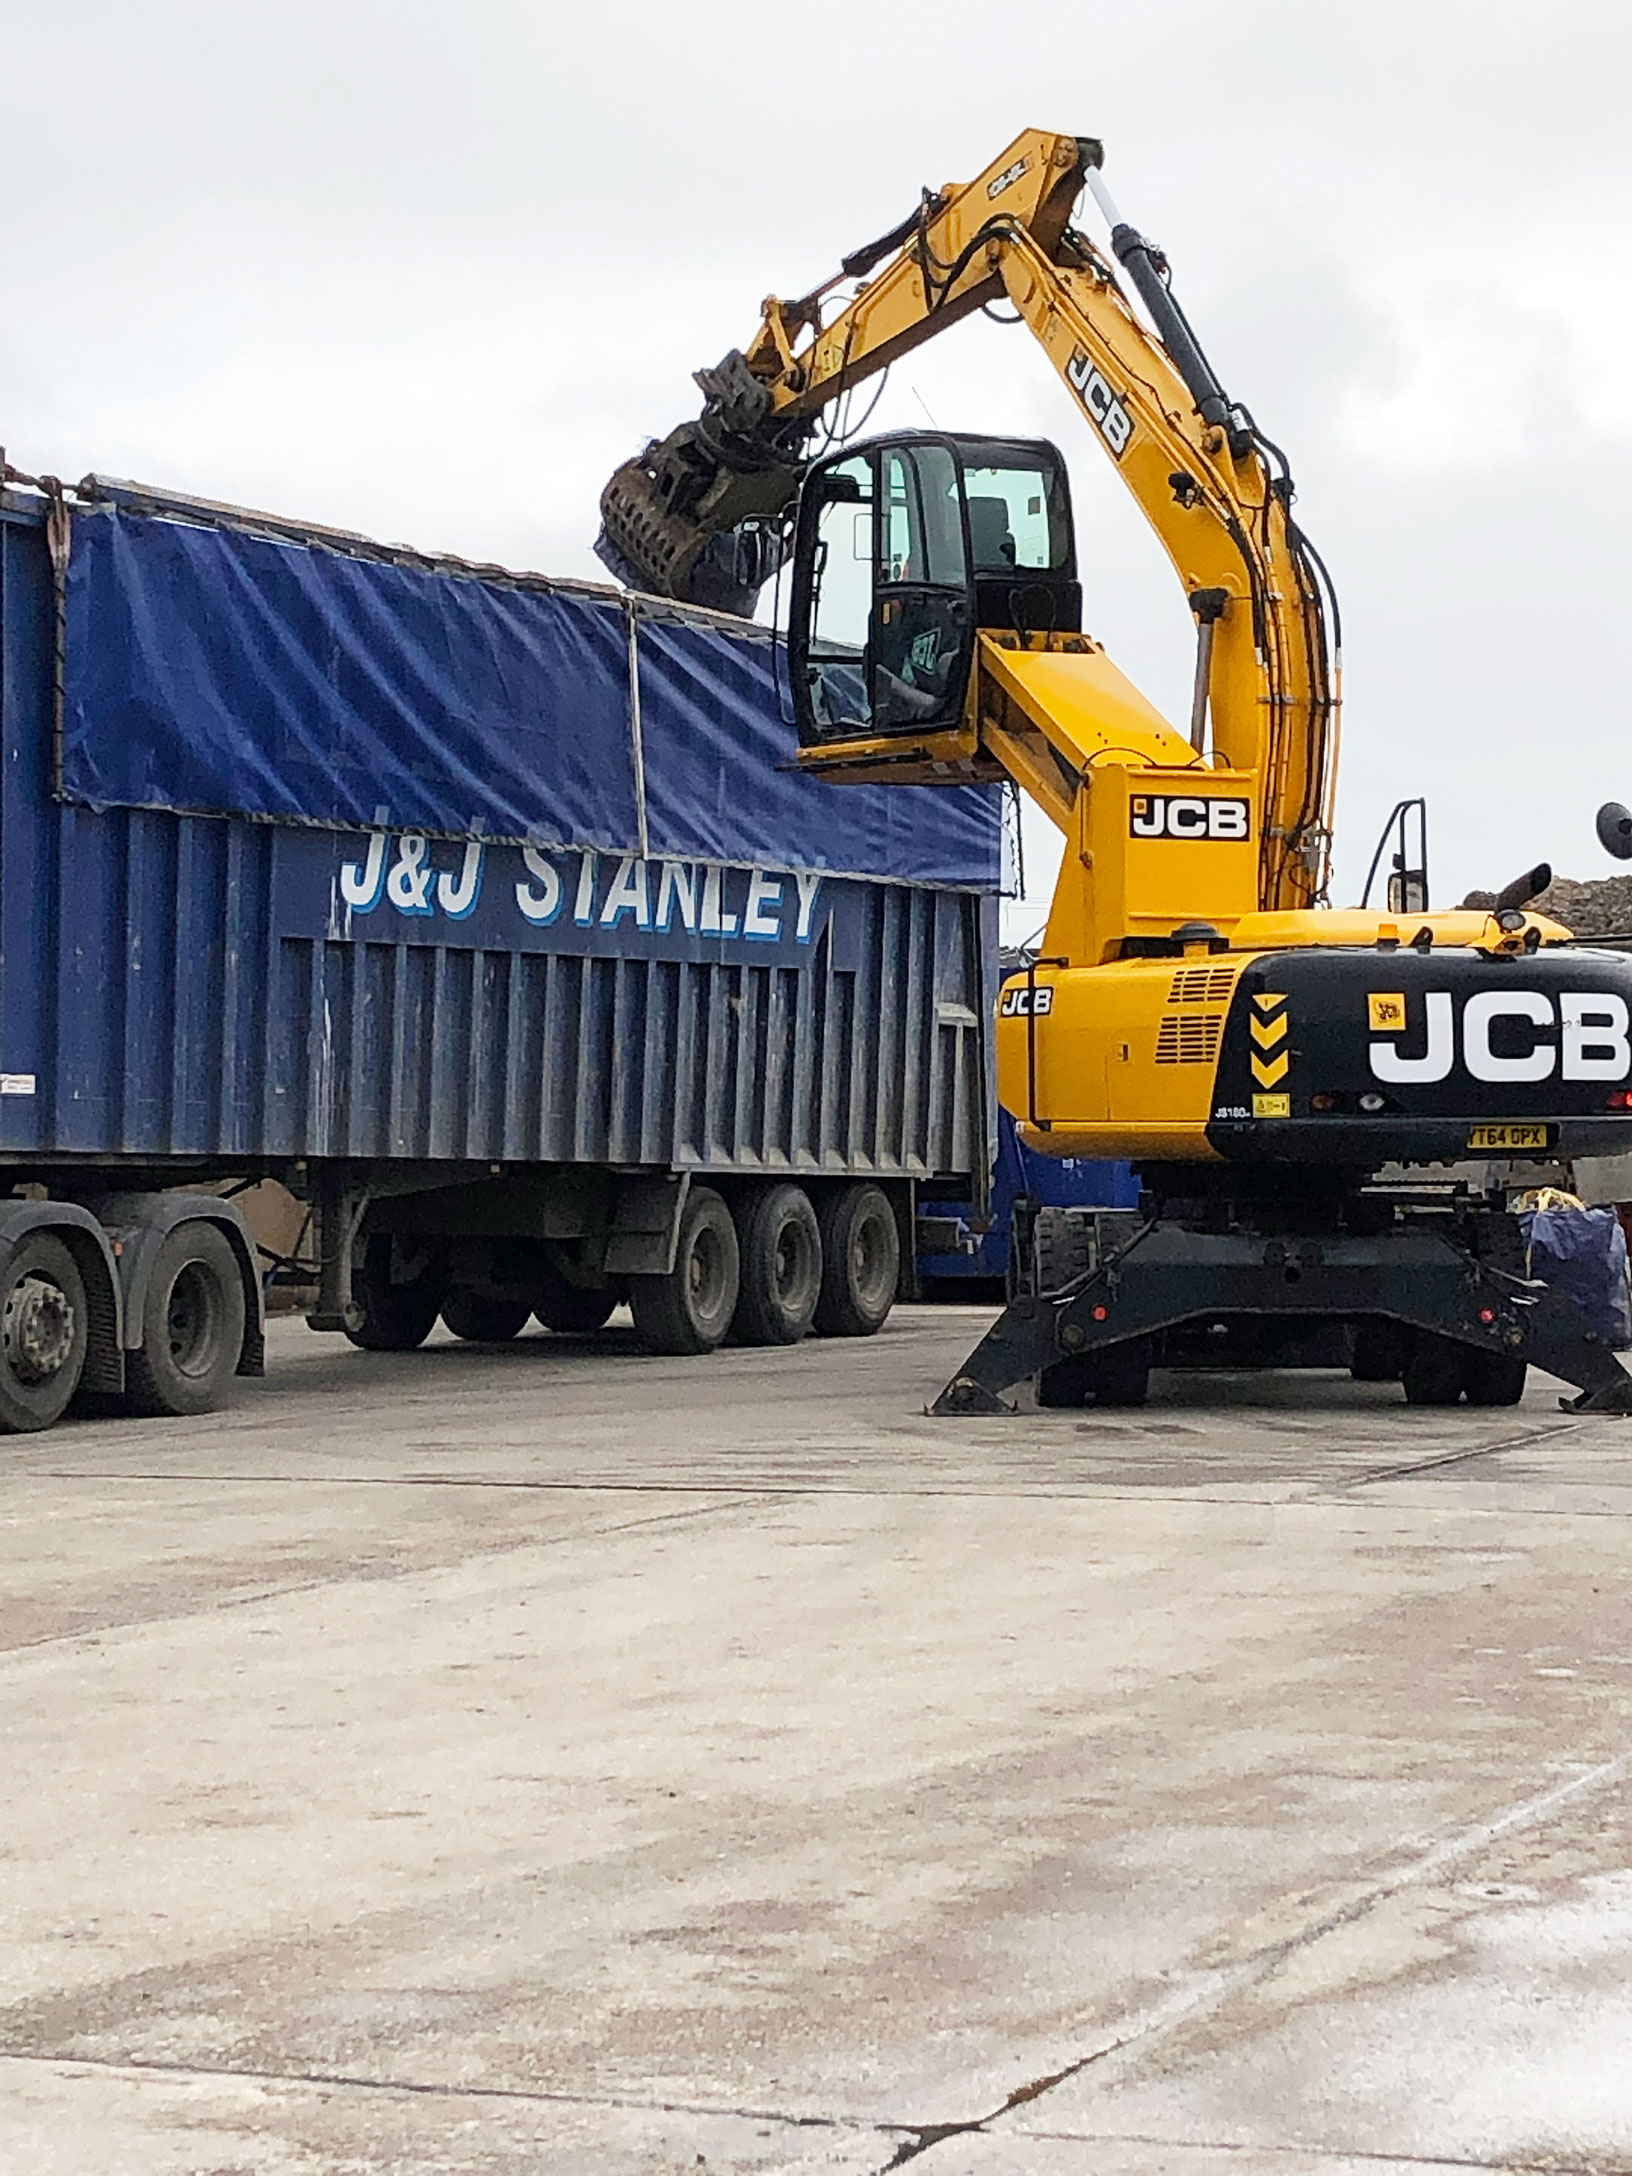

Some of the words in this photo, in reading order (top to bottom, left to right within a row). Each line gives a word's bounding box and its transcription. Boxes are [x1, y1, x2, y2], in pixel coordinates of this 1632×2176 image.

[1068, 357, 1130, 454] JCB
[1133, 798, 1248, 838] JCB
[341, 832, 487, 919] J&J
[1002, 989, 1052, 1016] JCB
[1368, 991, 1631, 1084] JCB
